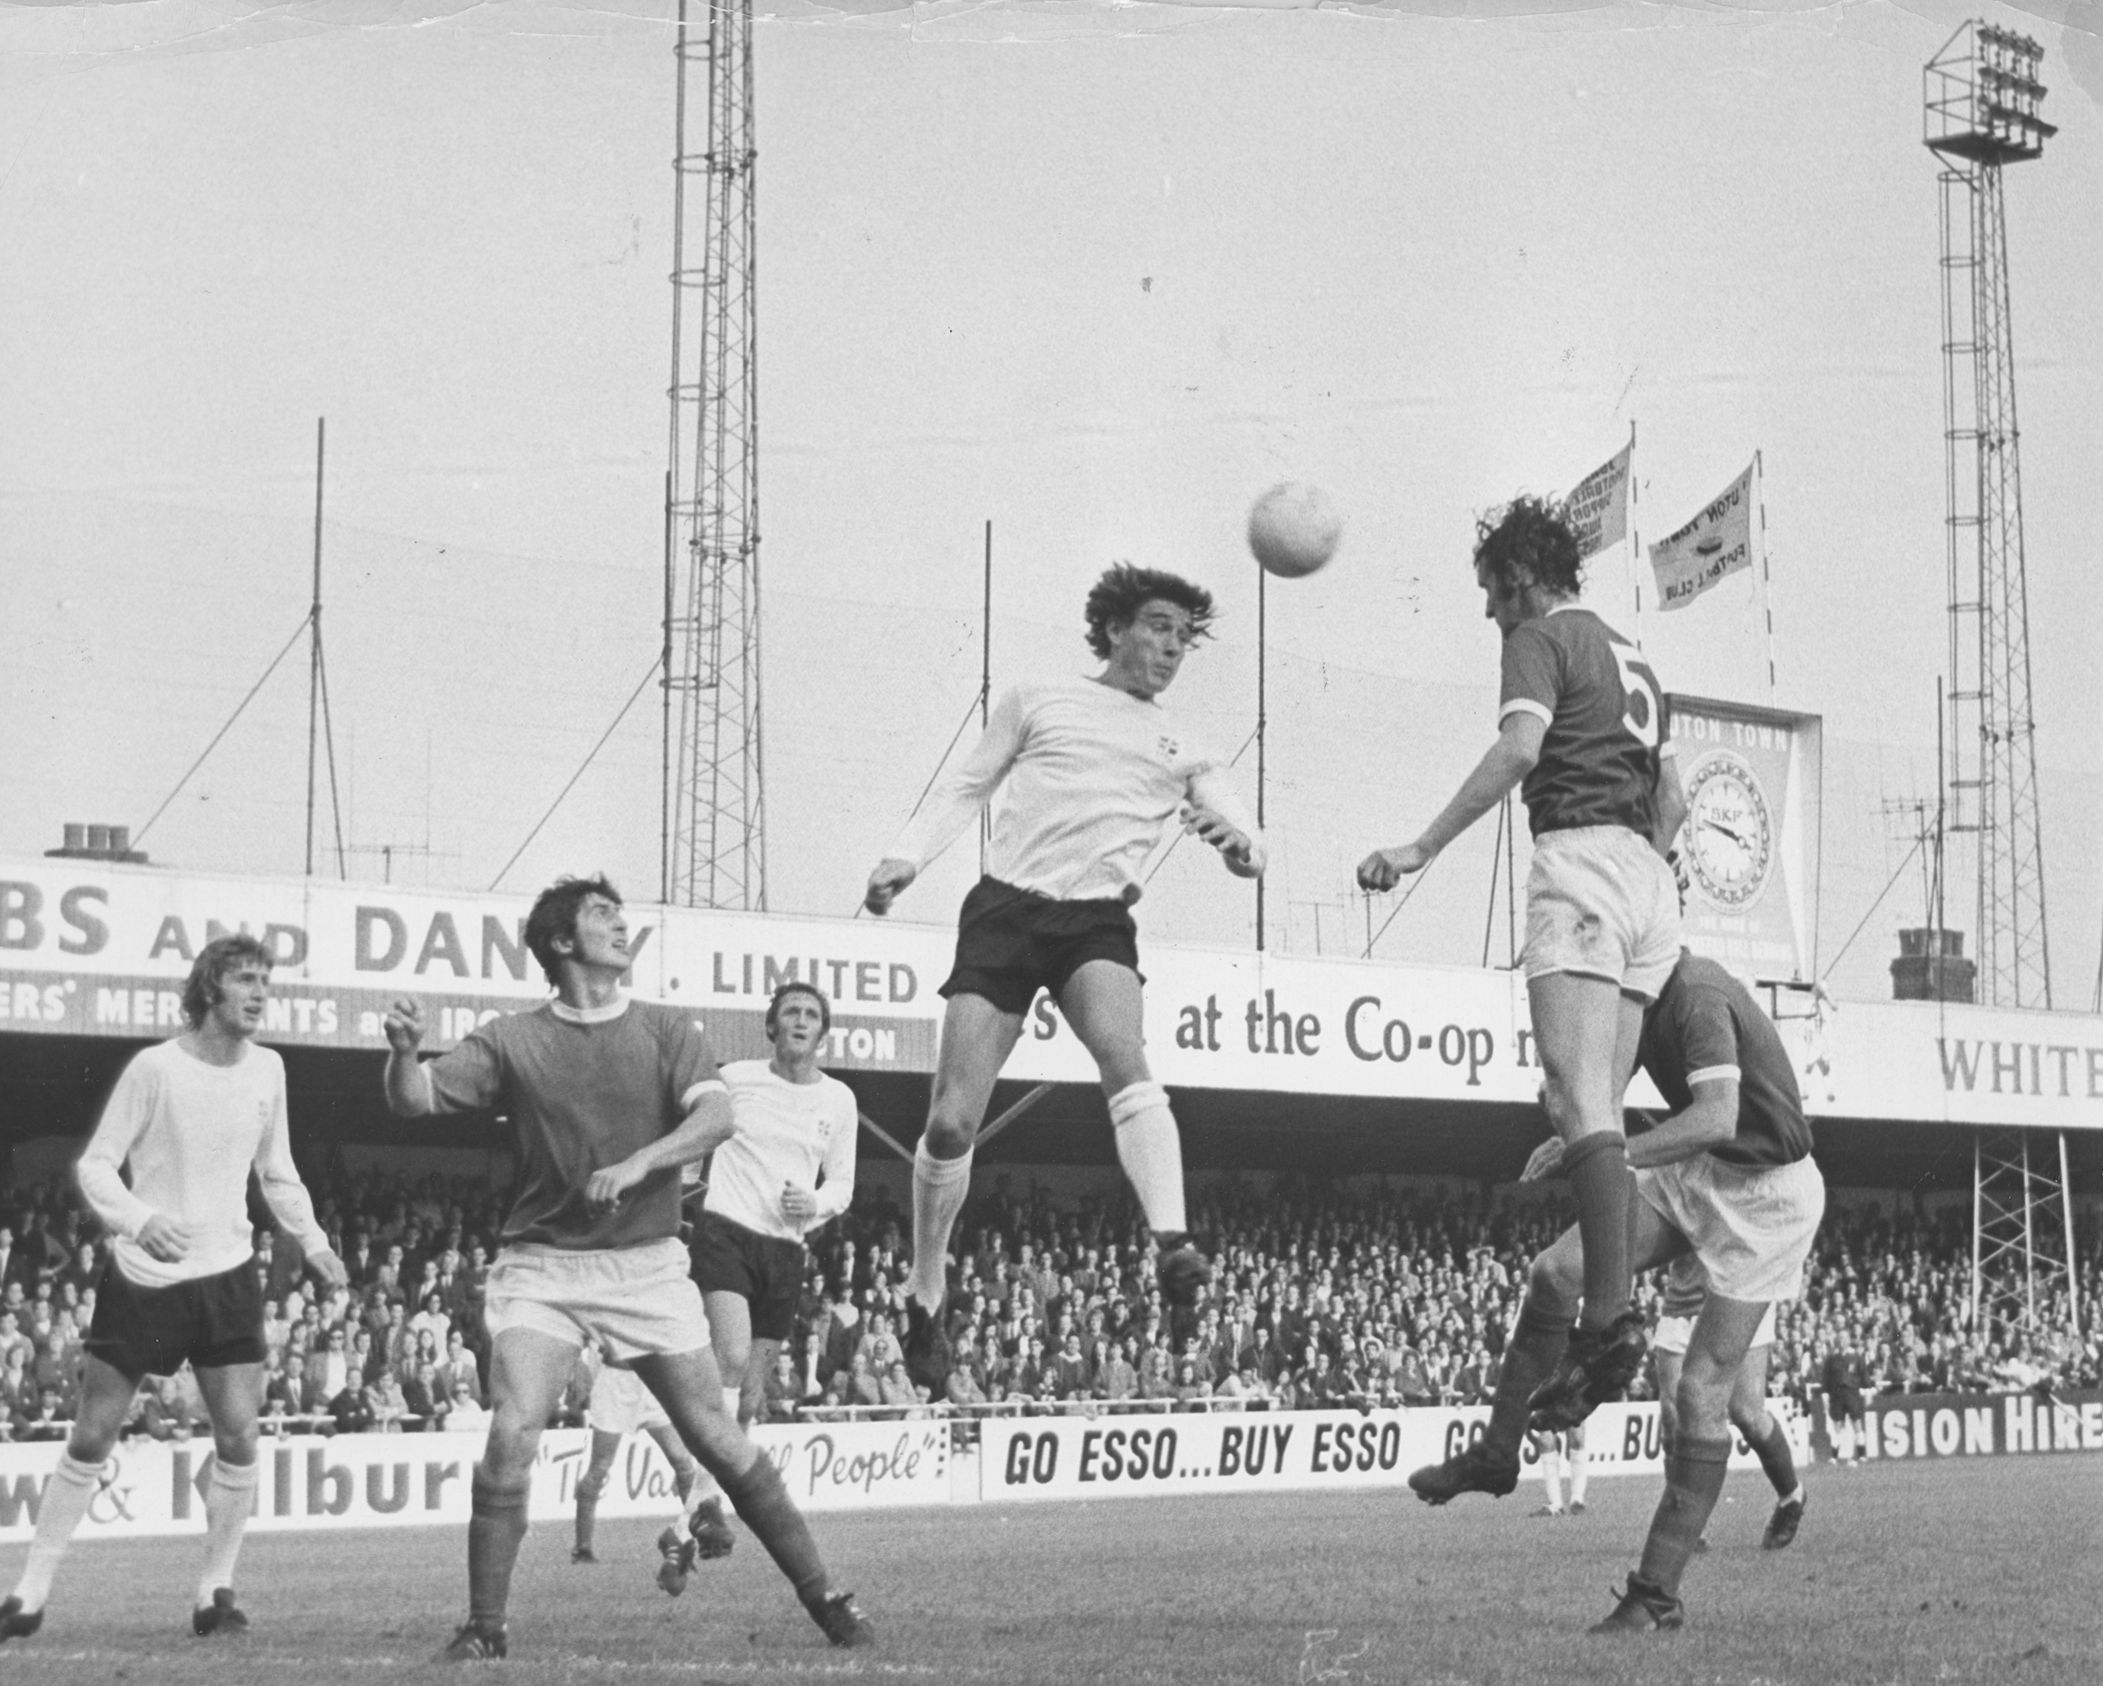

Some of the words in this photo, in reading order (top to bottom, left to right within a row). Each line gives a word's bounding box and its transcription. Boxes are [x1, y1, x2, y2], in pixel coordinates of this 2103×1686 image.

[1608, 640, 1659, 748] 5
[1670, 713, 1721, 742] UTON
[1733, 722, 1788, 752] TOWN
[713, 951, 918, 1003] LIMITED
[1176, 994, 1222, 1052] at
[1246, 989, 1322, 1056] the
[1345, 995, 1494, 1085] Co-op
[1005, 1431, 1059, 1485] GO
[1311, 1421, 1401, 1473] ESSO
[2005, 1395, 2103, 1453] HIRE
